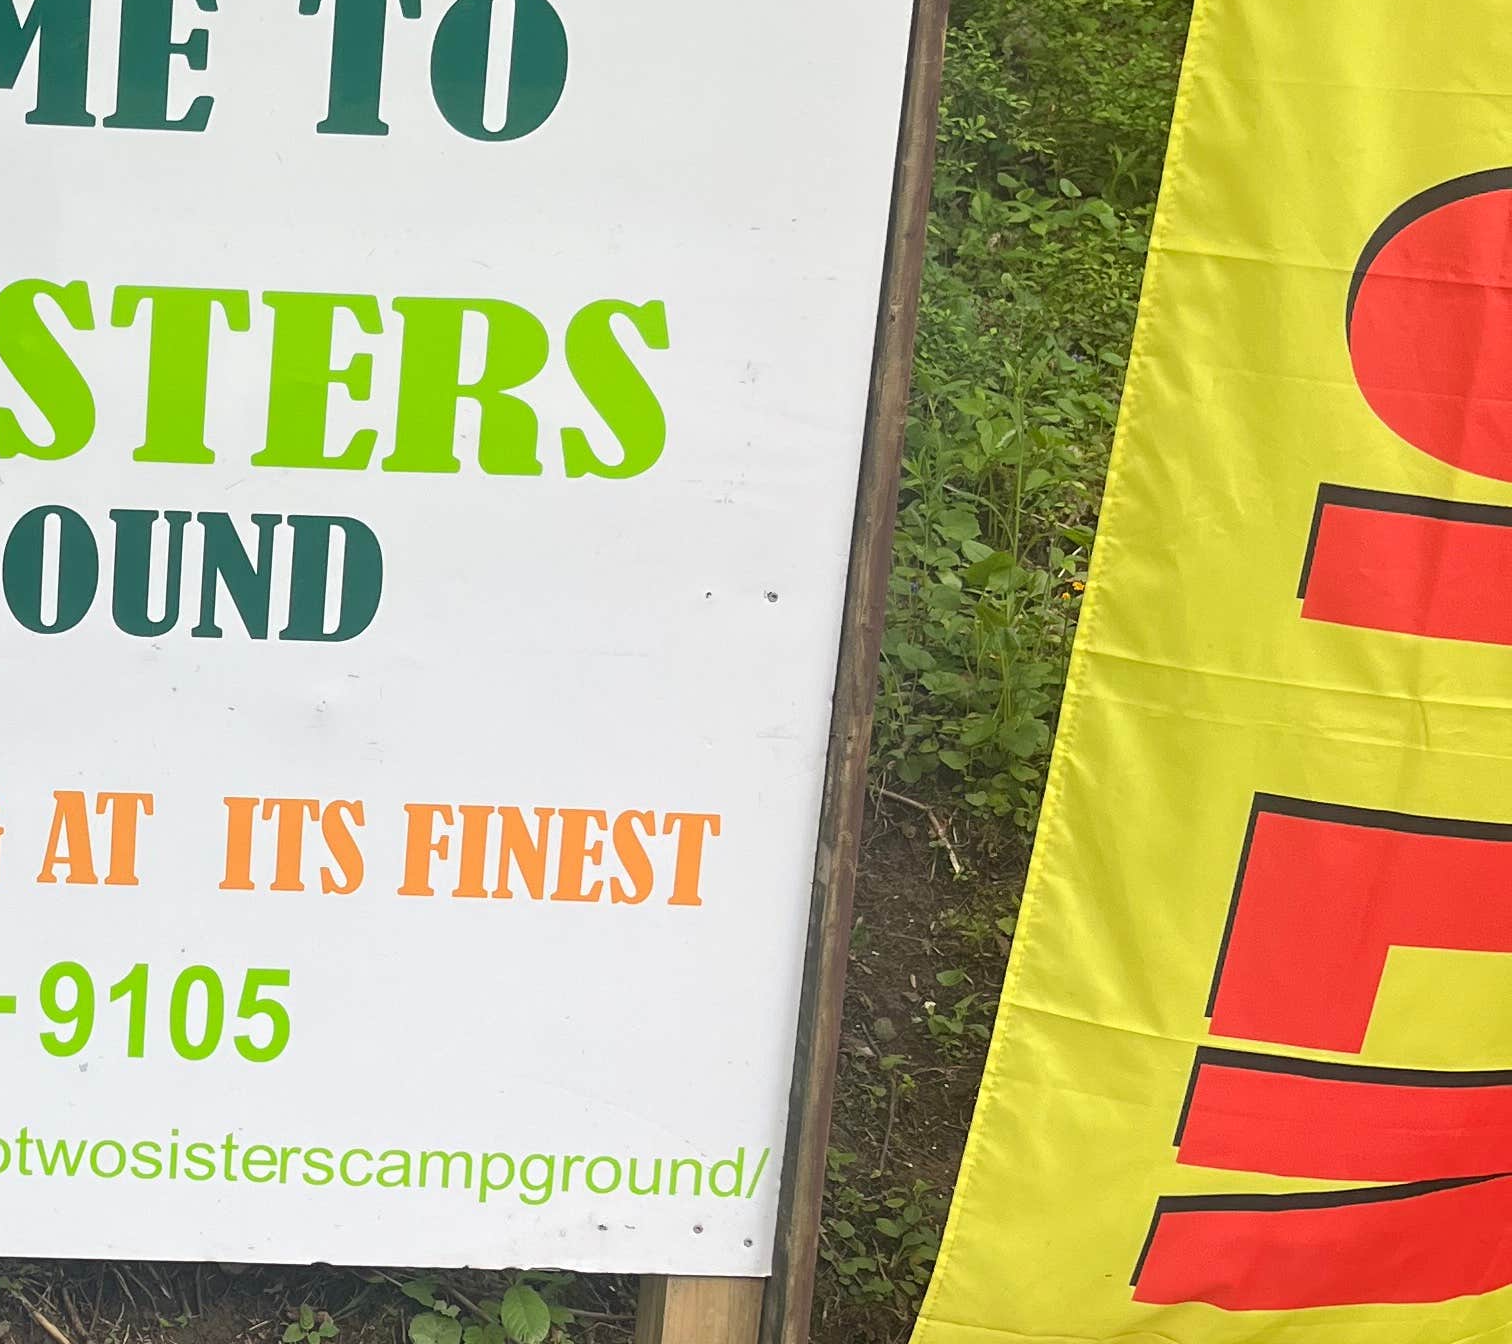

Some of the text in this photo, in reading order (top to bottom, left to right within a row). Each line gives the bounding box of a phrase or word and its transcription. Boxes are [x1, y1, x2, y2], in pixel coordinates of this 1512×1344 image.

[36, 789, 154, 886] AT
[218, 796, 365, 895] ITS
[396, 803, 722, 907] FINEST
